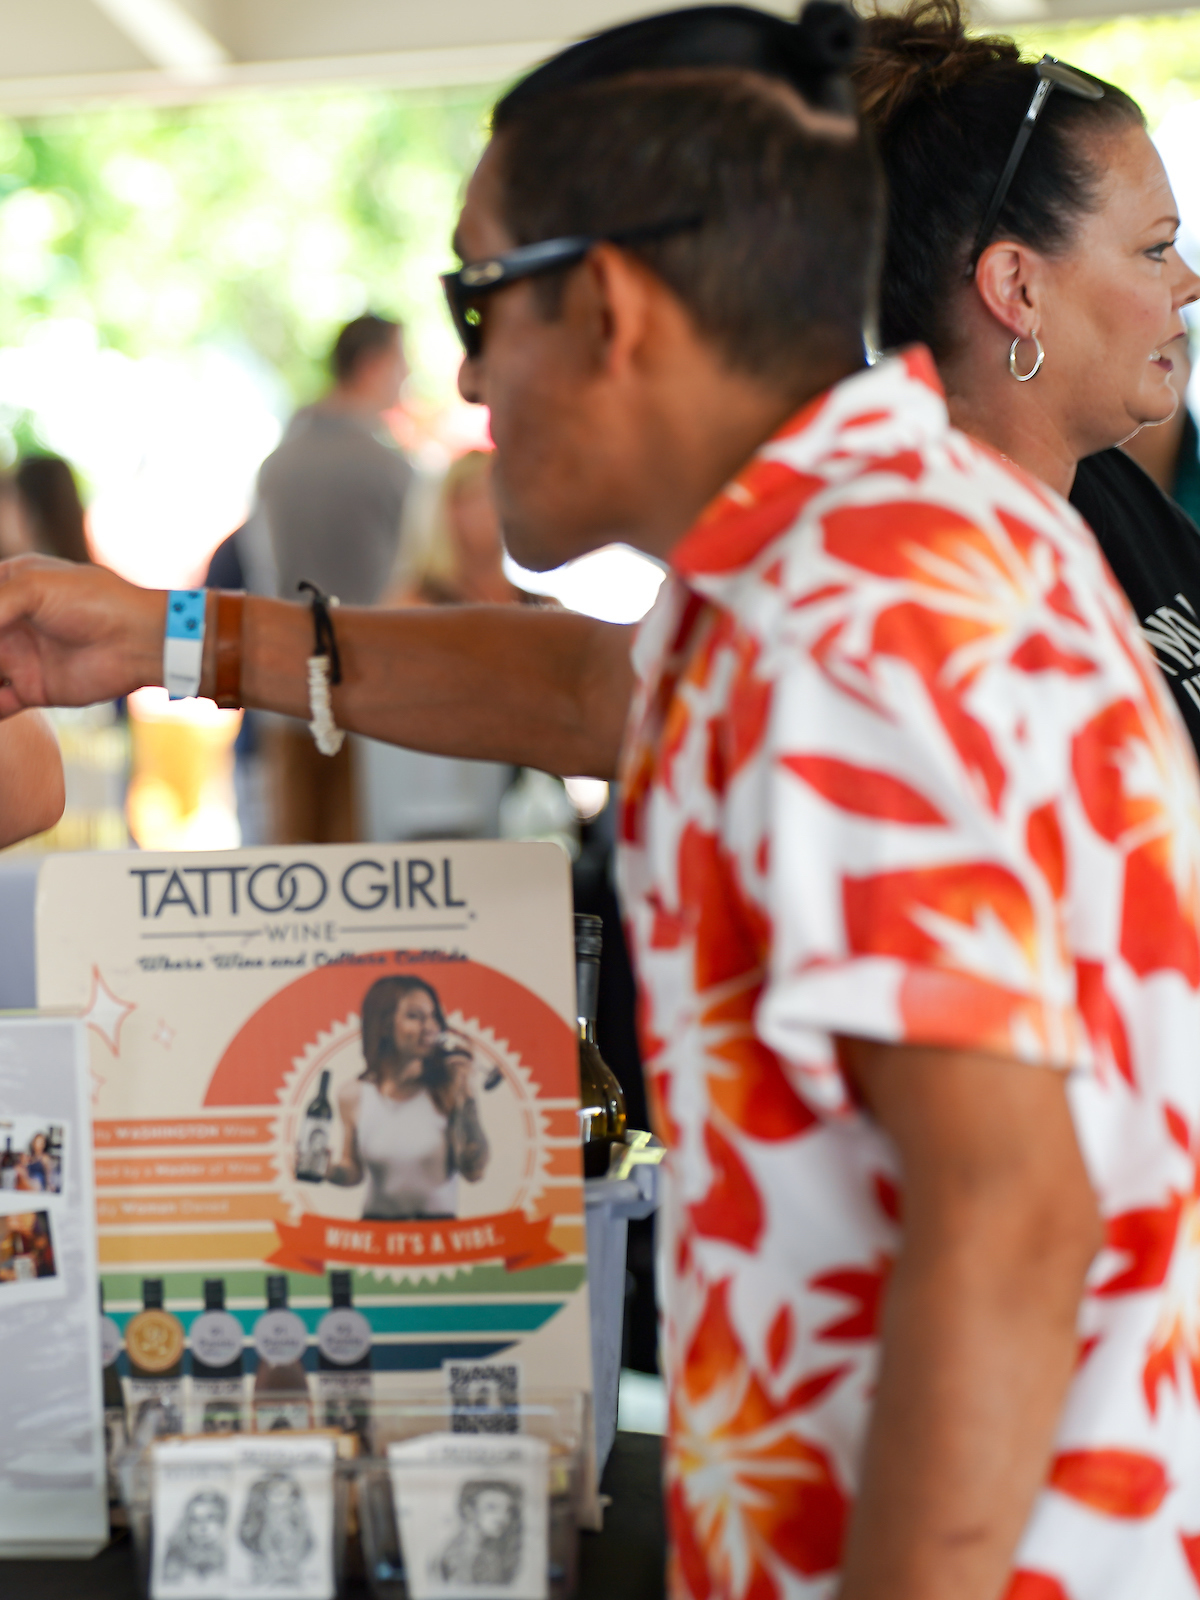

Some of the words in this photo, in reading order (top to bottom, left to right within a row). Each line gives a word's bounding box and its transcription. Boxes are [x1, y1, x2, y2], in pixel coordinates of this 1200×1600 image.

[130, 862, 328, 917] TATTOO
[341, 857, 467, 911] GIRL
[263, 921, 338, 943] WINE
